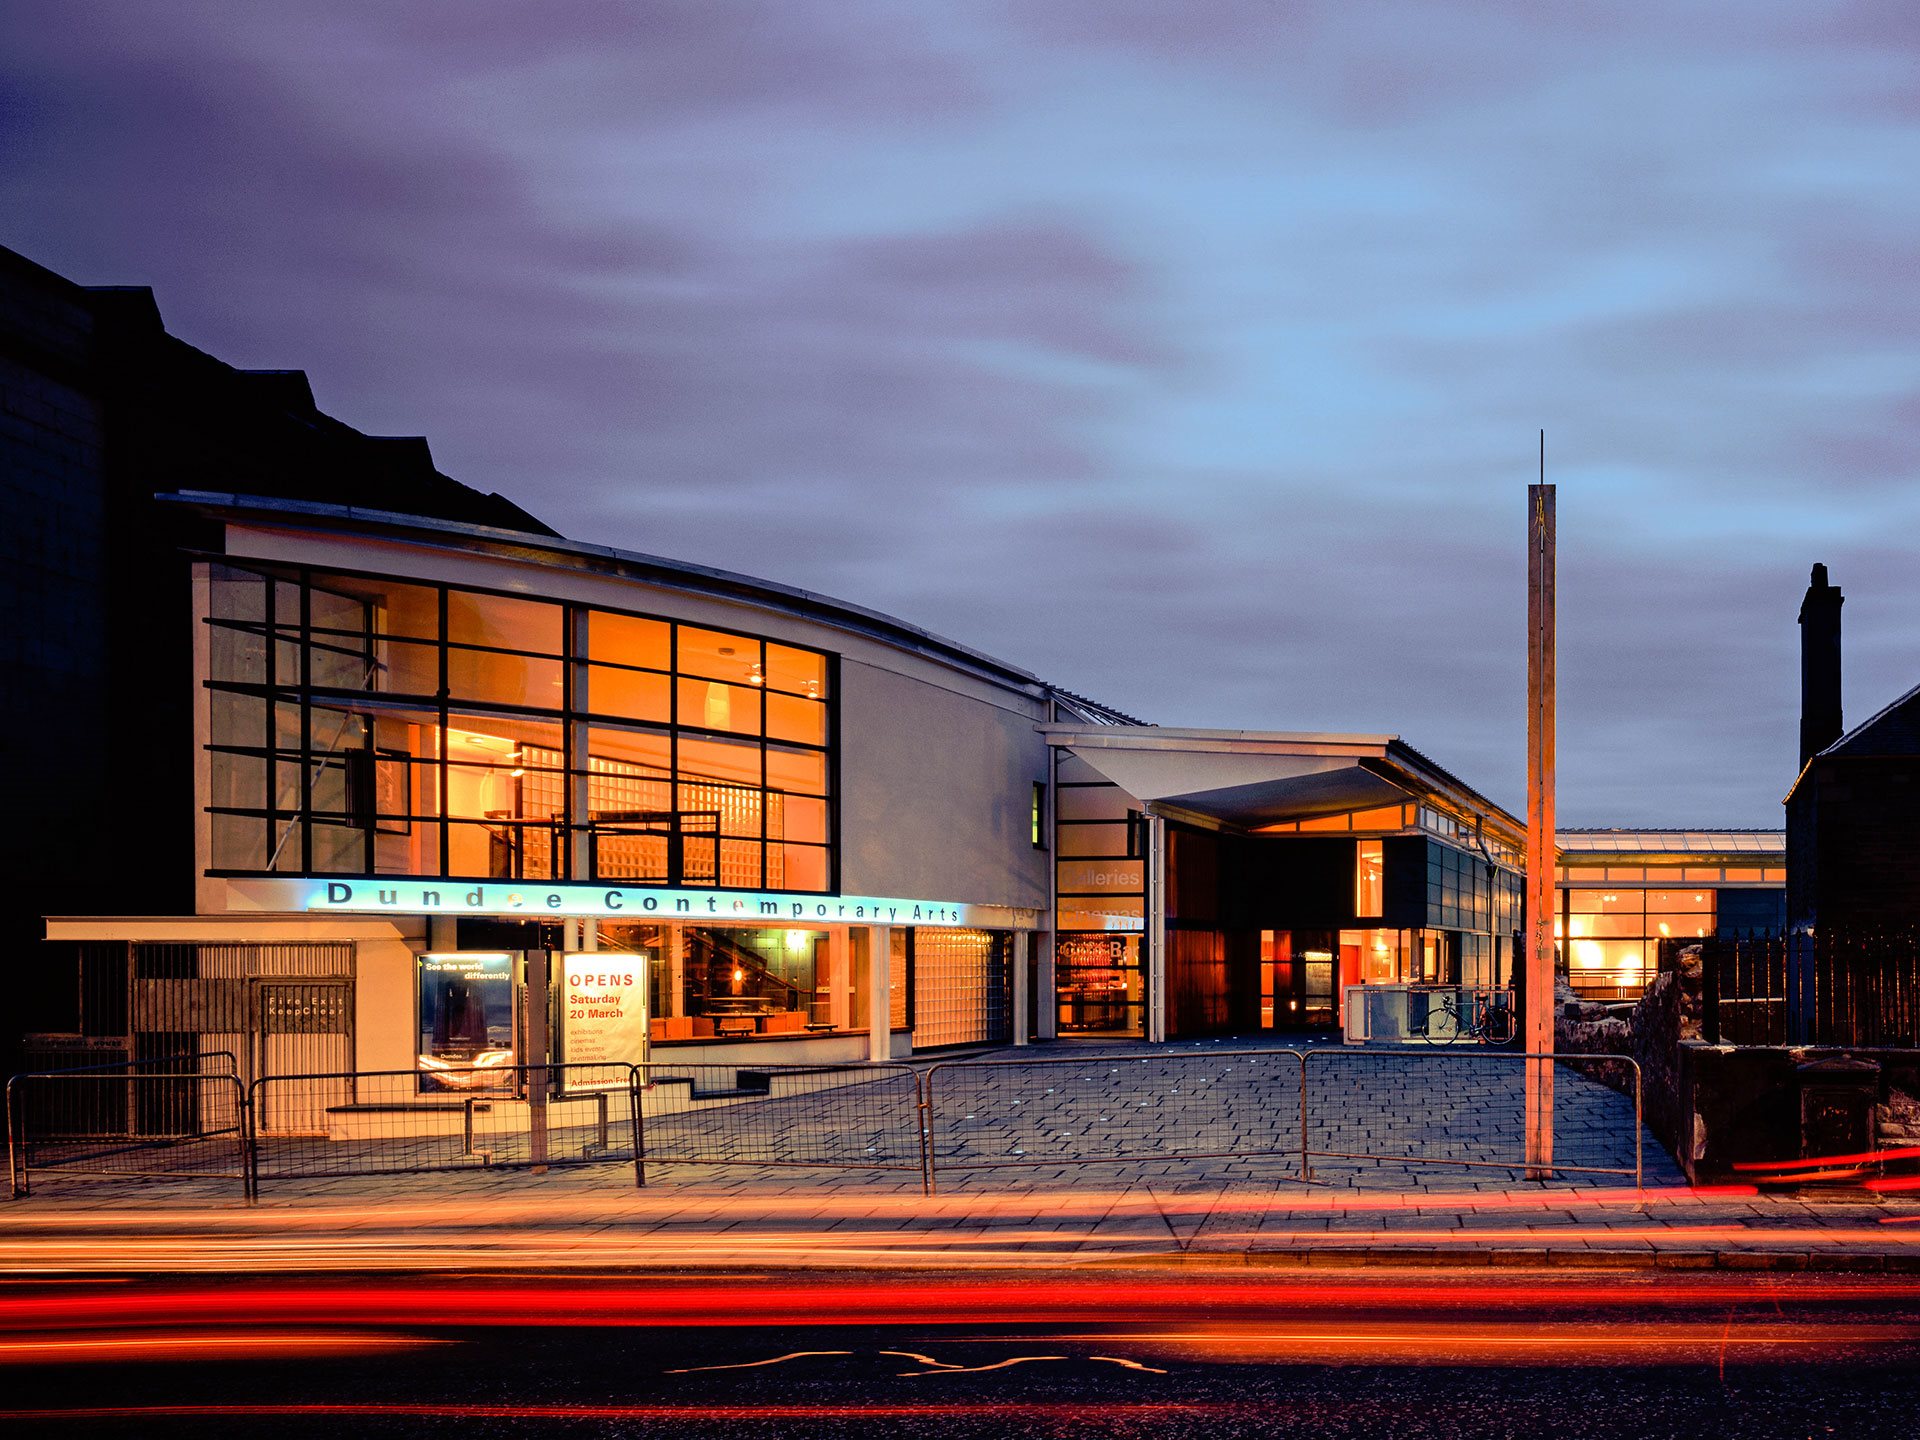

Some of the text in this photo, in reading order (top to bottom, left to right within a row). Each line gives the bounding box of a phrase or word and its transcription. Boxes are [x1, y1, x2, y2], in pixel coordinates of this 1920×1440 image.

[327, 881, 958, 922] Dundee Contemporary Arts
[426, 962, 484, 971] See the world
[464, 972, 510, 981] differently
[569, 974, 634, 987] OPENS
[269, 997, 343, 1005] Fire Exit
[570, 994, 621, 1005] Saturday
[570, 1009, 623, 1019] 20 March
[571, 1077, 614, 1087] Admission
